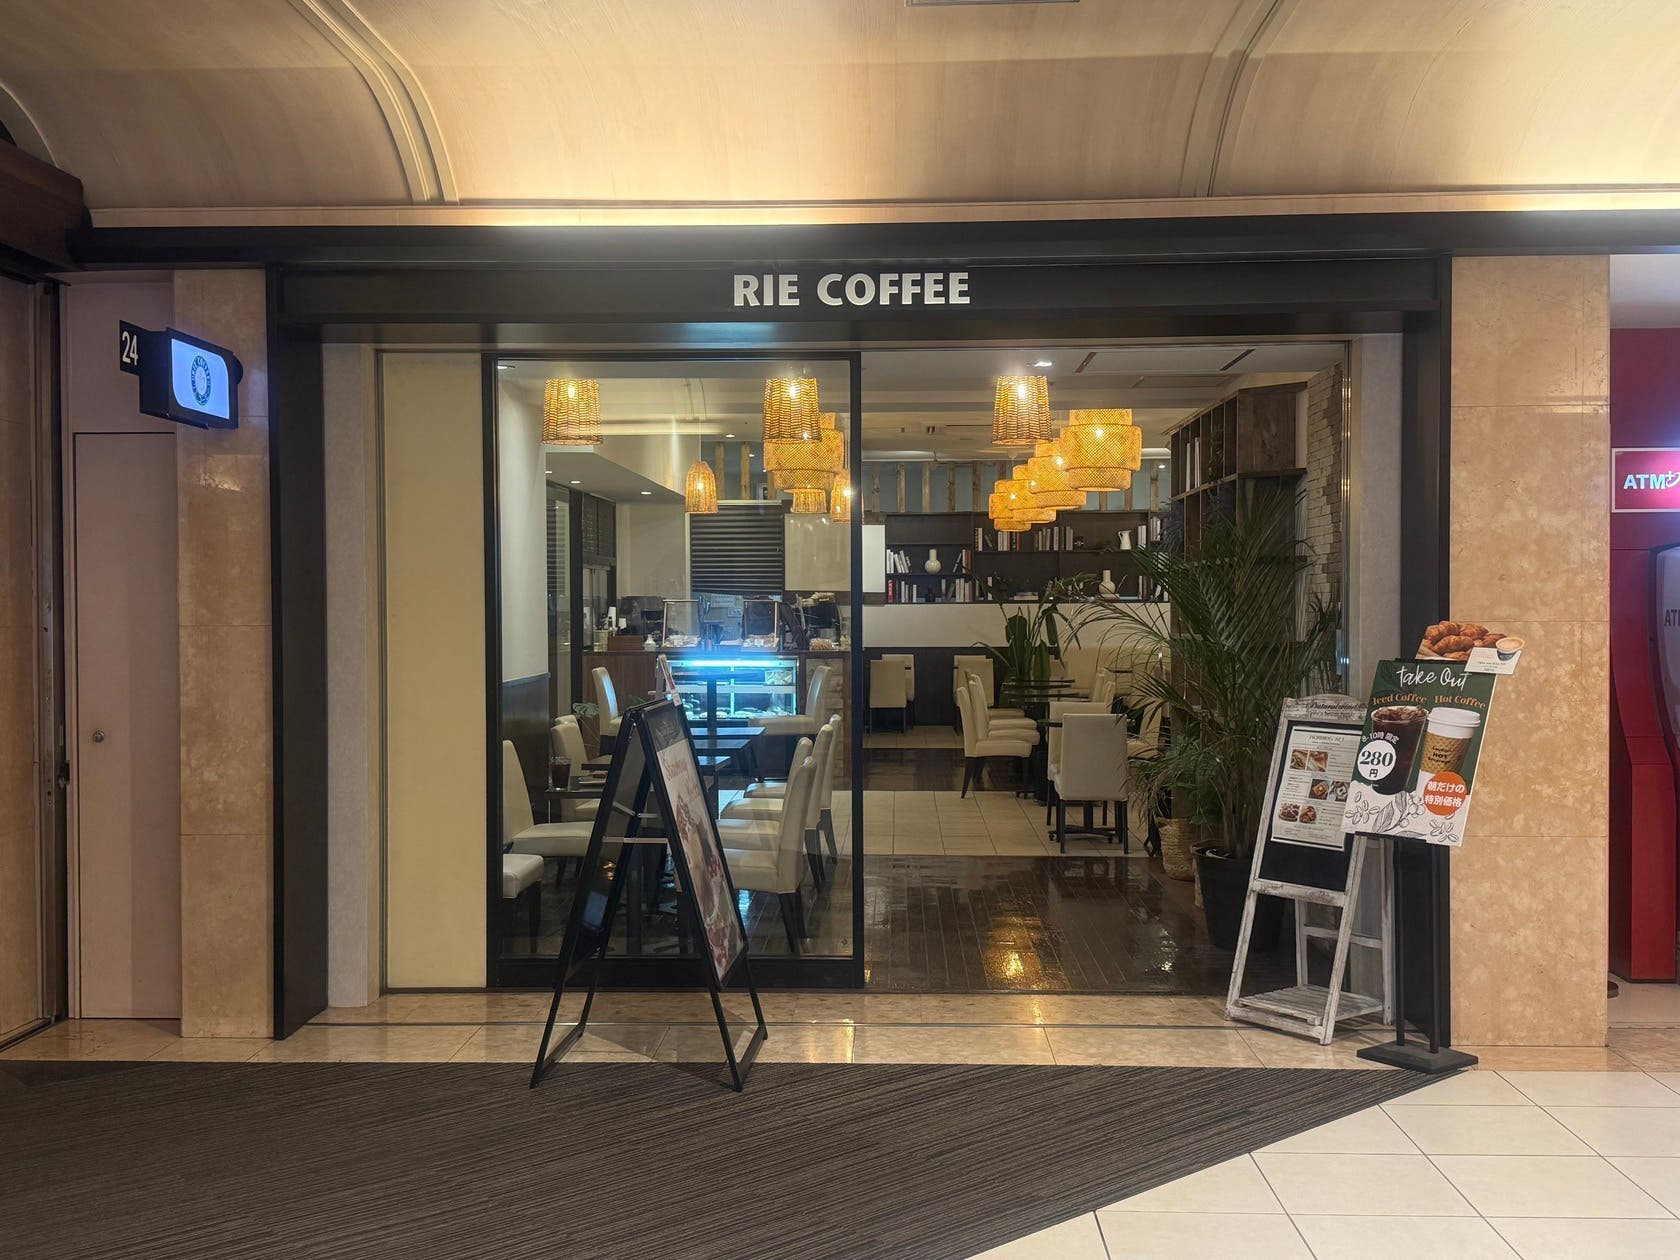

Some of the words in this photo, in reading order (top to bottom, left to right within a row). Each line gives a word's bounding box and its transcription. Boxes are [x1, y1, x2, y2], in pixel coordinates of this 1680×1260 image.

[733, 274, 800, 307] RIE
[816, 272, 971, 306] COFFEE
[122, 331, 138, 365] 24
[1623, 473, 1666, 490] ATM
[1373, 693, 1393, 705] Iced
[1395, 693, 1427, 704] Coffee
[1434, 695, 1452, 704] Hot
[1454, 695, 1486, 709] Coffee
[1359, 750, 1394, 767] 280
[1368, 768, 1379, 778] 円
[1428, 781, 1464, 793] 朝だけの
[1425, 795, 1462, 807] 特別価格
